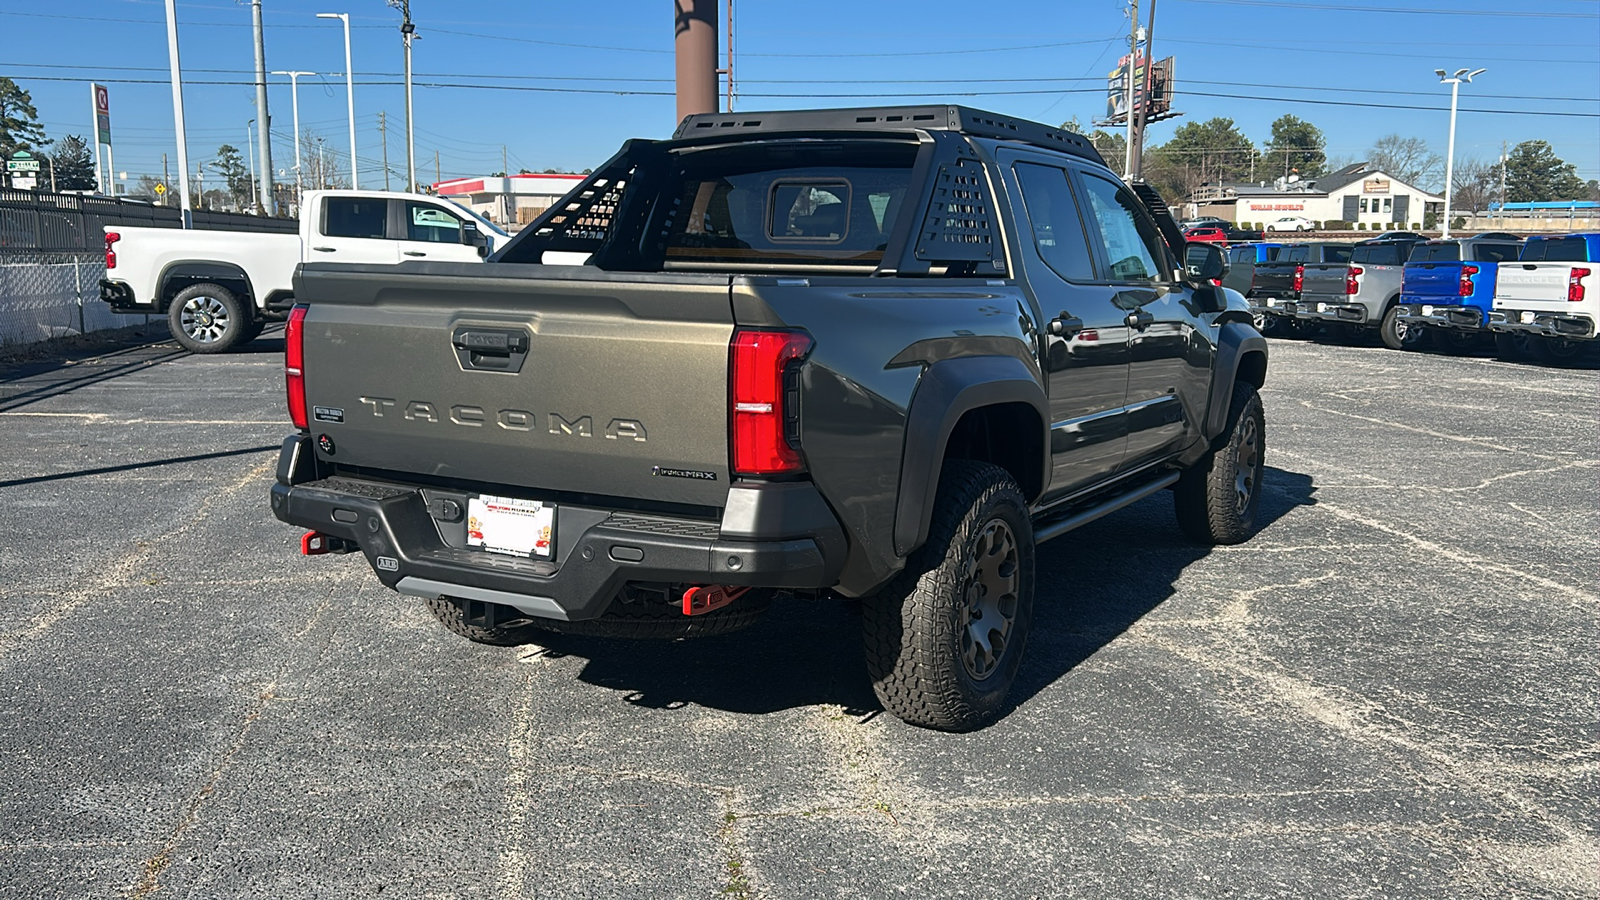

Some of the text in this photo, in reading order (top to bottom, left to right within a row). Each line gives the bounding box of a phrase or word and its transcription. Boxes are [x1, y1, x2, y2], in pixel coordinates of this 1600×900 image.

[470, 335, 506, 346] TOYOTA
[358, 396, 647, 442] TACOMA
[487, 504, 511, 512] MILTON
[380, 558, 397, 569] ARB
